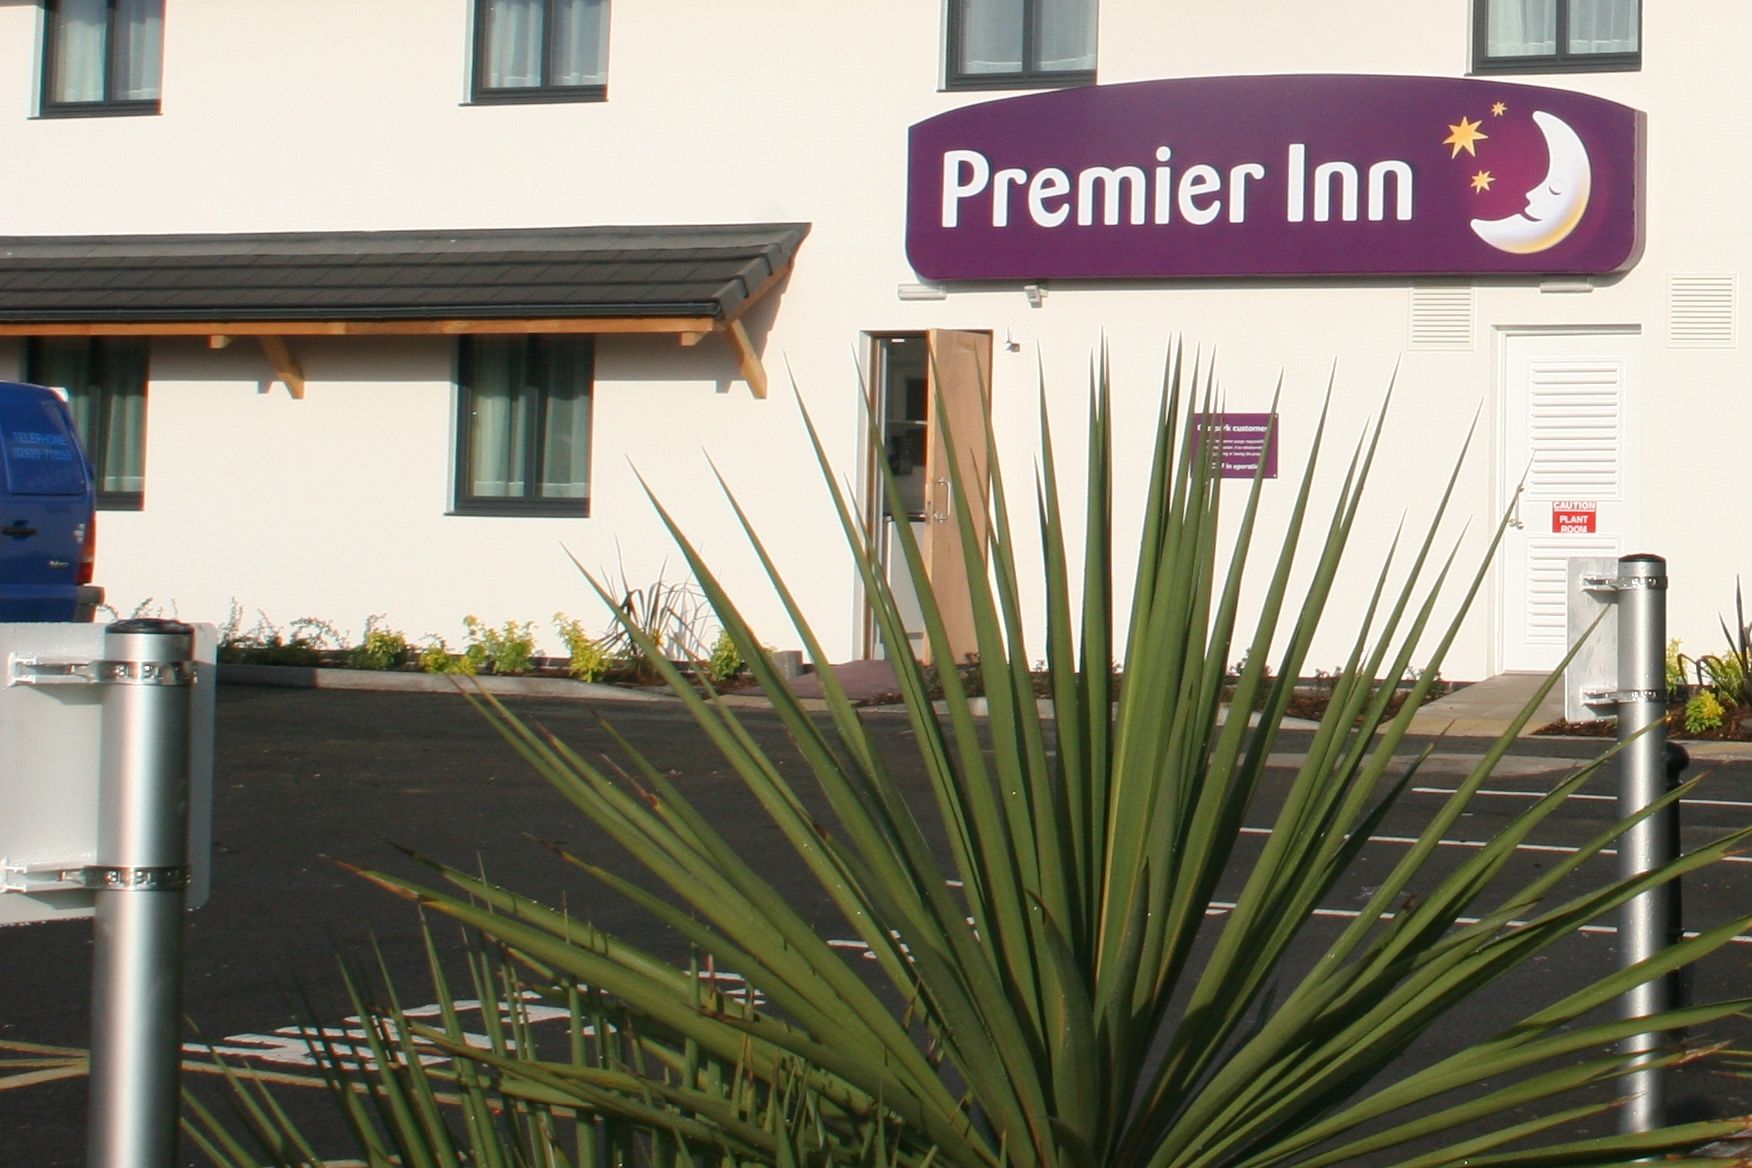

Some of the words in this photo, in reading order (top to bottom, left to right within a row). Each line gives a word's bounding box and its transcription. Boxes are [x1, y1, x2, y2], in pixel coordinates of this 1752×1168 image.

[941, 146, 1264, 228] Premier
[1287, 143, 1414, 223] Inn
[1553, 501, 1595, 509] CAUTION
[1559, 515, 1589, 523] PLANT
[1560, 525, 1587, 533] ROOM
